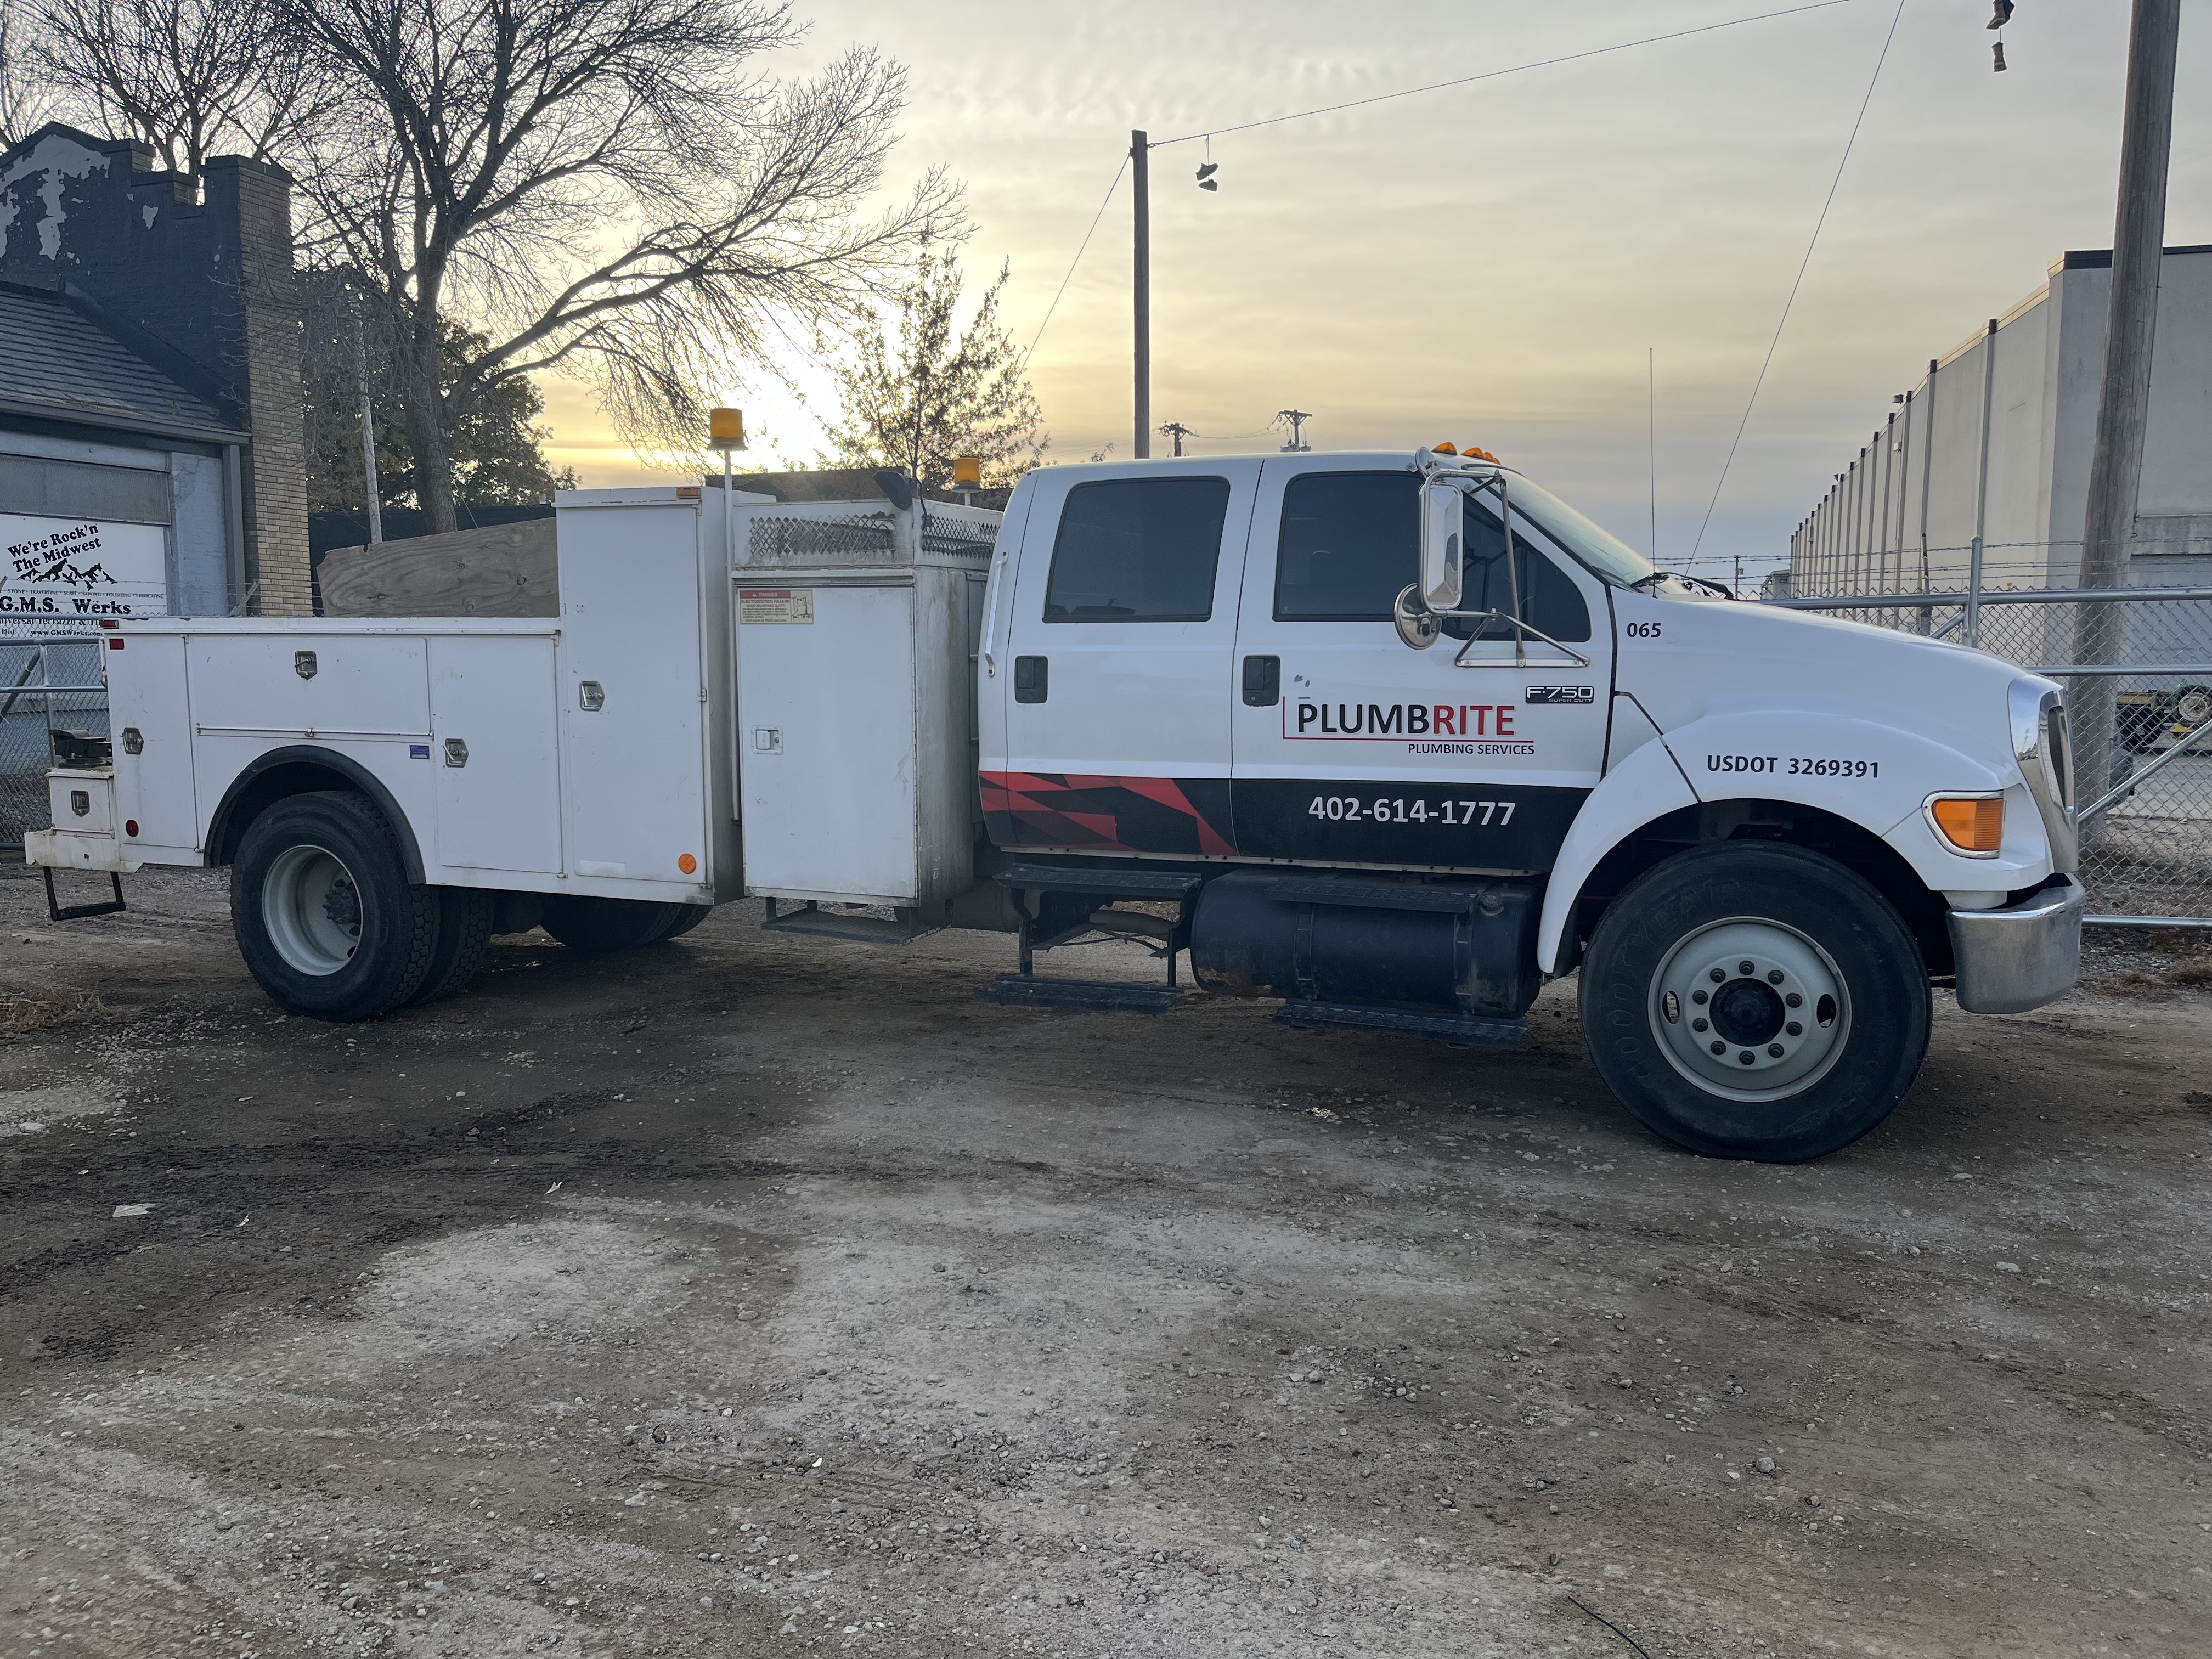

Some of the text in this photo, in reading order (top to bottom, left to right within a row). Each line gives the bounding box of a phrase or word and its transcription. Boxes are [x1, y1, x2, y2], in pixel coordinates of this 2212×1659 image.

[7, 524, 99, 558] We're Rock'n
[12, 537, 101, 572] The Midwest
[0, 596, 131, 614] G.M.S. Wërks
[1626, 622, 1661, 638] 065
[1298, 703, 1516, 736] PLUMBRITE
[1408, 744, 1535, 755] PLUMBING SERVICES
[1707, 755, 1879, 778] USDOT 3269391
[1308, 796, 1516, 826] 402-614-1777
